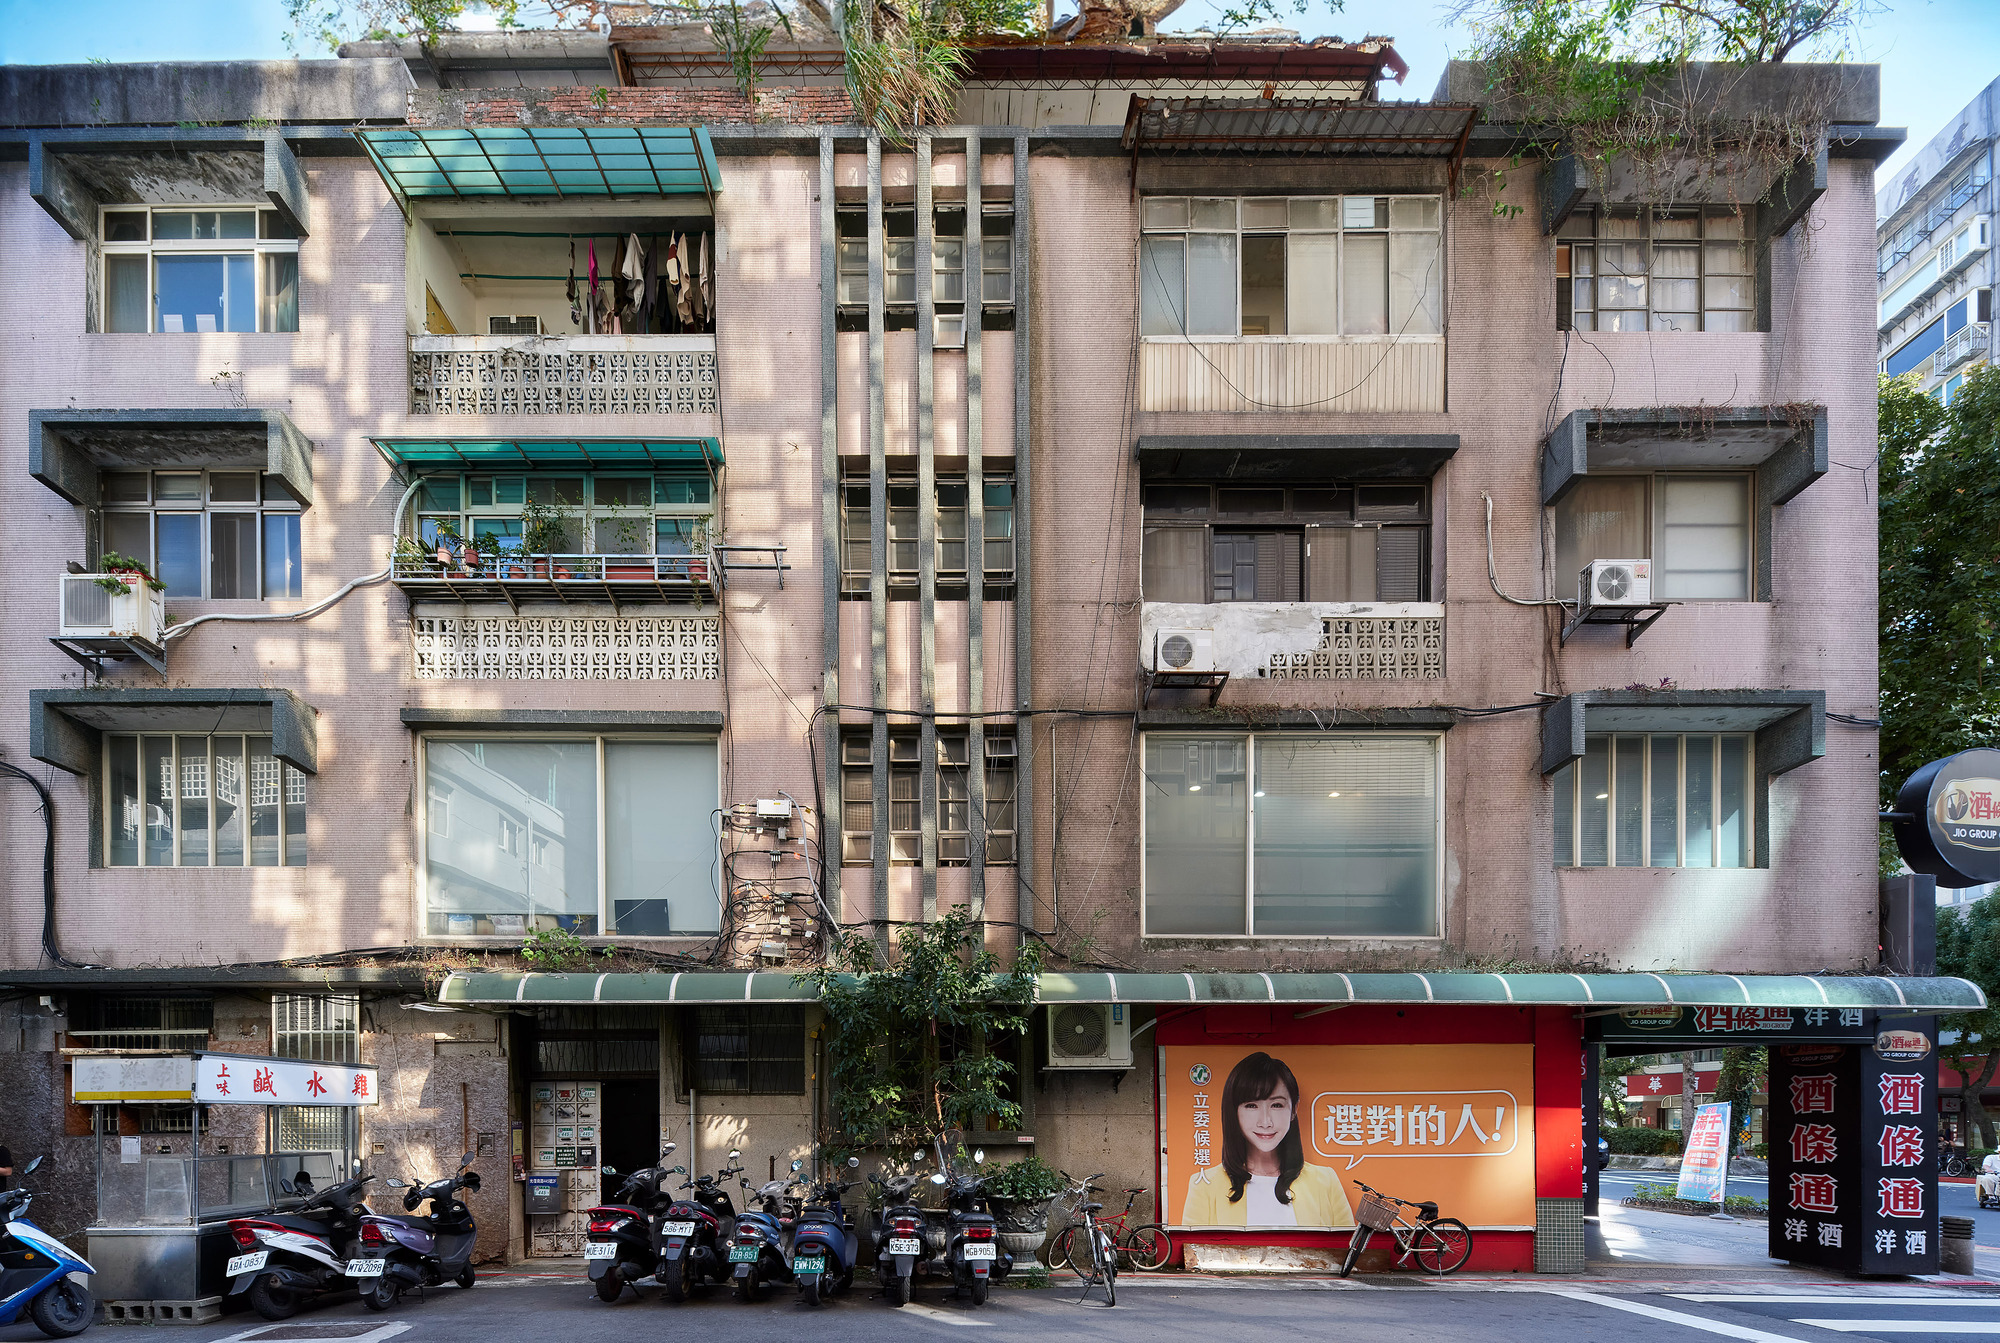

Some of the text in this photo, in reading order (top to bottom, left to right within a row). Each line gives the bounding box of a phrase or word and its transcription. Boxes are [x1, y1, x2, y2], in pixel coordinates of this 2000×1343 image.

[1952, 828, 1997, 839] JIO GROUP
[216, 1063, 231, 1096] 上味
[253, 1066, 370, 1100] 鹹水雞
[1193, 1091, 1211, 1185] 立委候選人
[1323, 1103, 1505, 1146] 選對的人!
[1788, 1072, 1839, 1214] 酒條通
[1877, 1072, 1925, 1219] 酒條通
[890, 1243, 919, 1253] K5E-373
[1784, 1218, 1843, 1248] 洋酒
[1875, 1229, 1927, 1255] 洋酒
[228, 1255, 265, 1273] ABA-0837
[965, 1247, 995, 1256] MGB-9052
